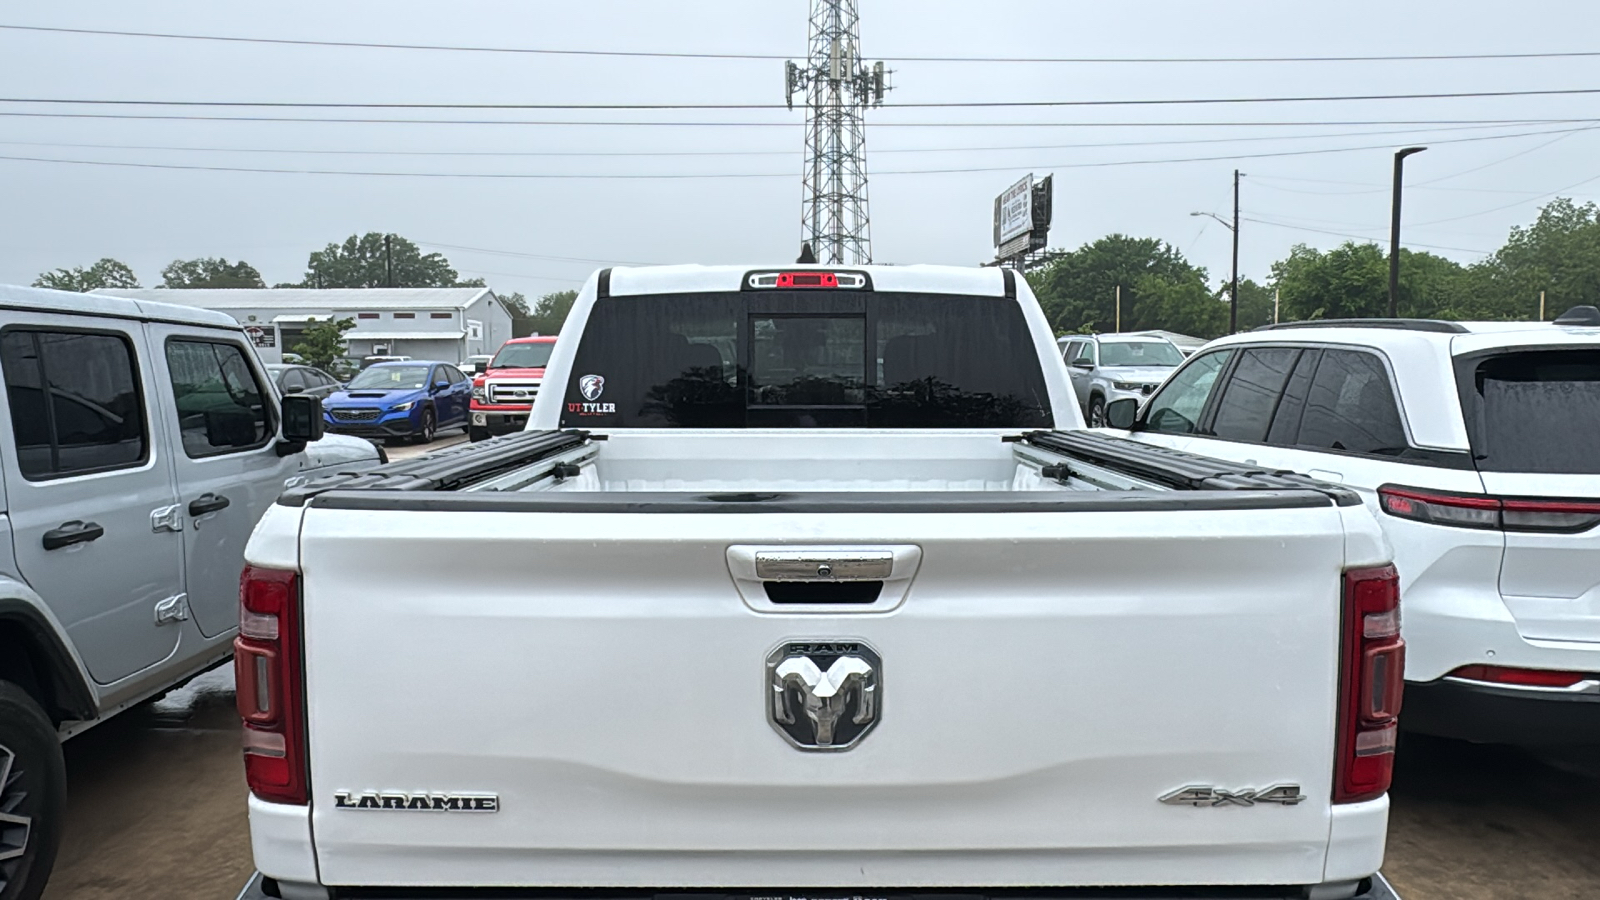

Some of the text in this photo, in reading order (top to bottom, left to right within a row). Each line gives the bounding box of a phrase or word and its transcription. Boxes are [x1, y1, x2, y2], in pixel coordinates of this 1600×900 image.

[568, 403, 616, 413] UT TYLER
[789, 643, 859, 654] RAM
[334, 791, 499, 812] LARAMIE
